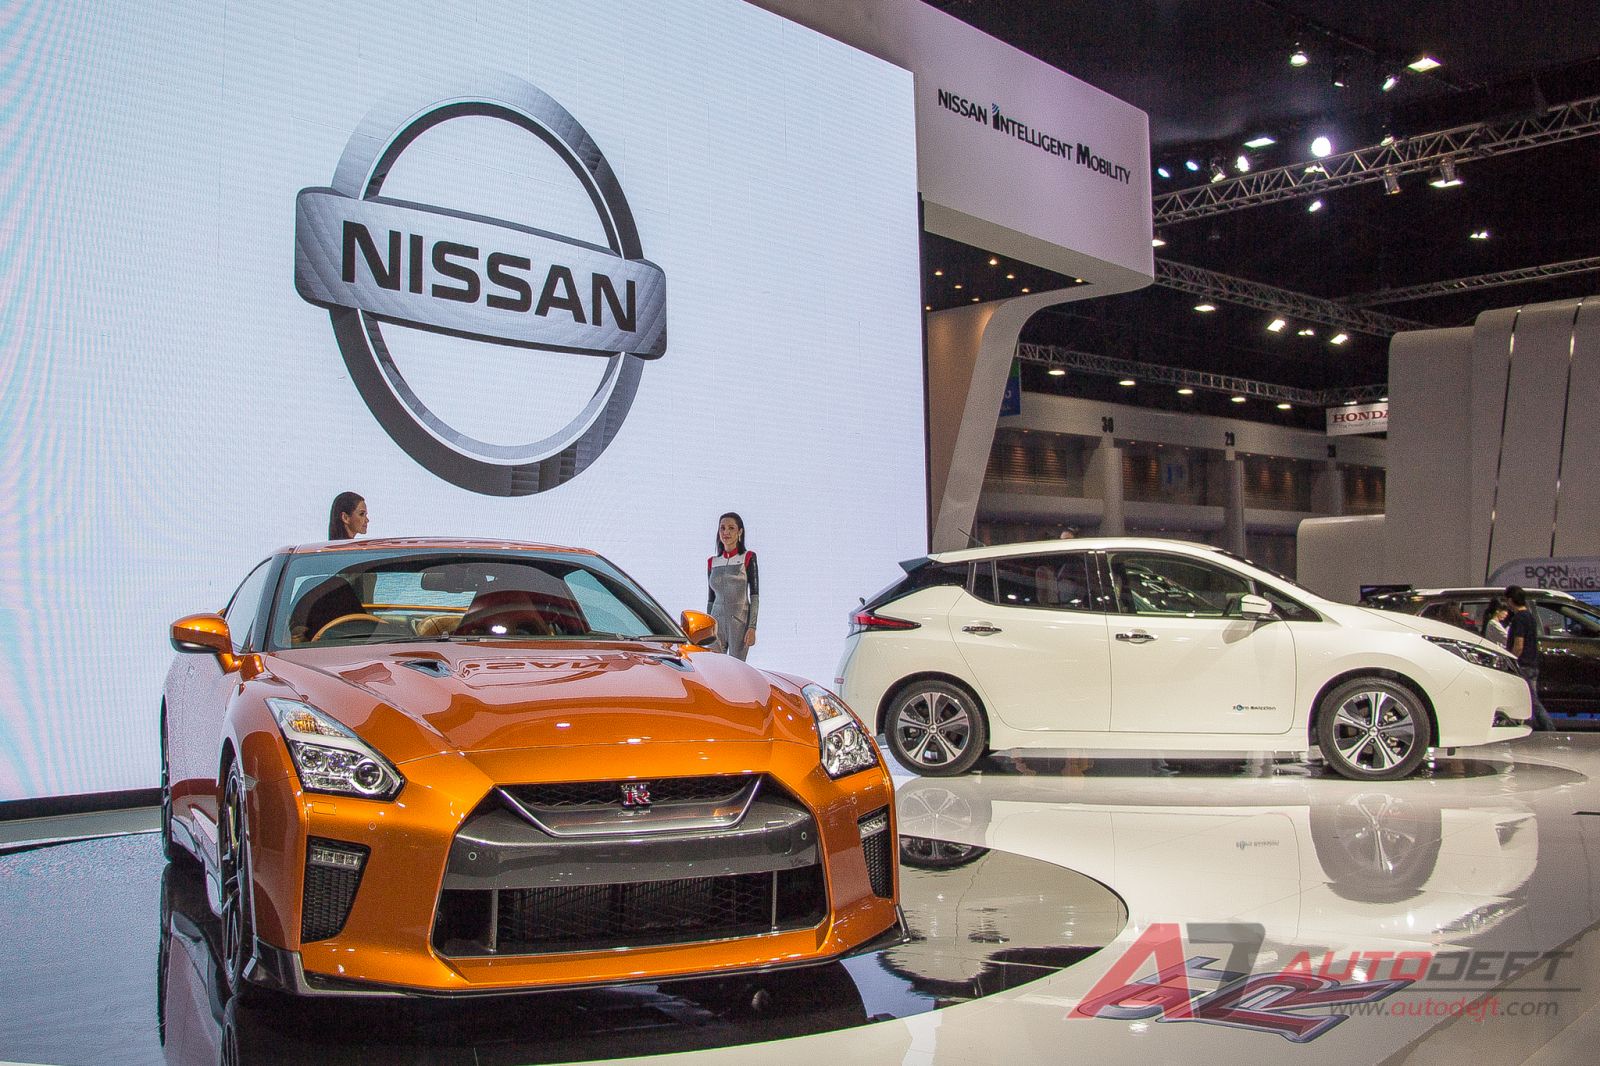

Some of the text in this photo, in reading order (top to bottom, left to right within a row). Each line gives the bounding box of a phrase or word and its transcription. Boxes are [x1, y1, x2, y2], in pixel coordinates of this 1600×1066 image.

[938, 88, 1131, 184] NISSAN INTELLIGENT MOBILITY
[341, 220, 636, 334] NISSAN
[1525, 565, 1568, 578] BORN
[1538, 577, 1595, 589] RACING
